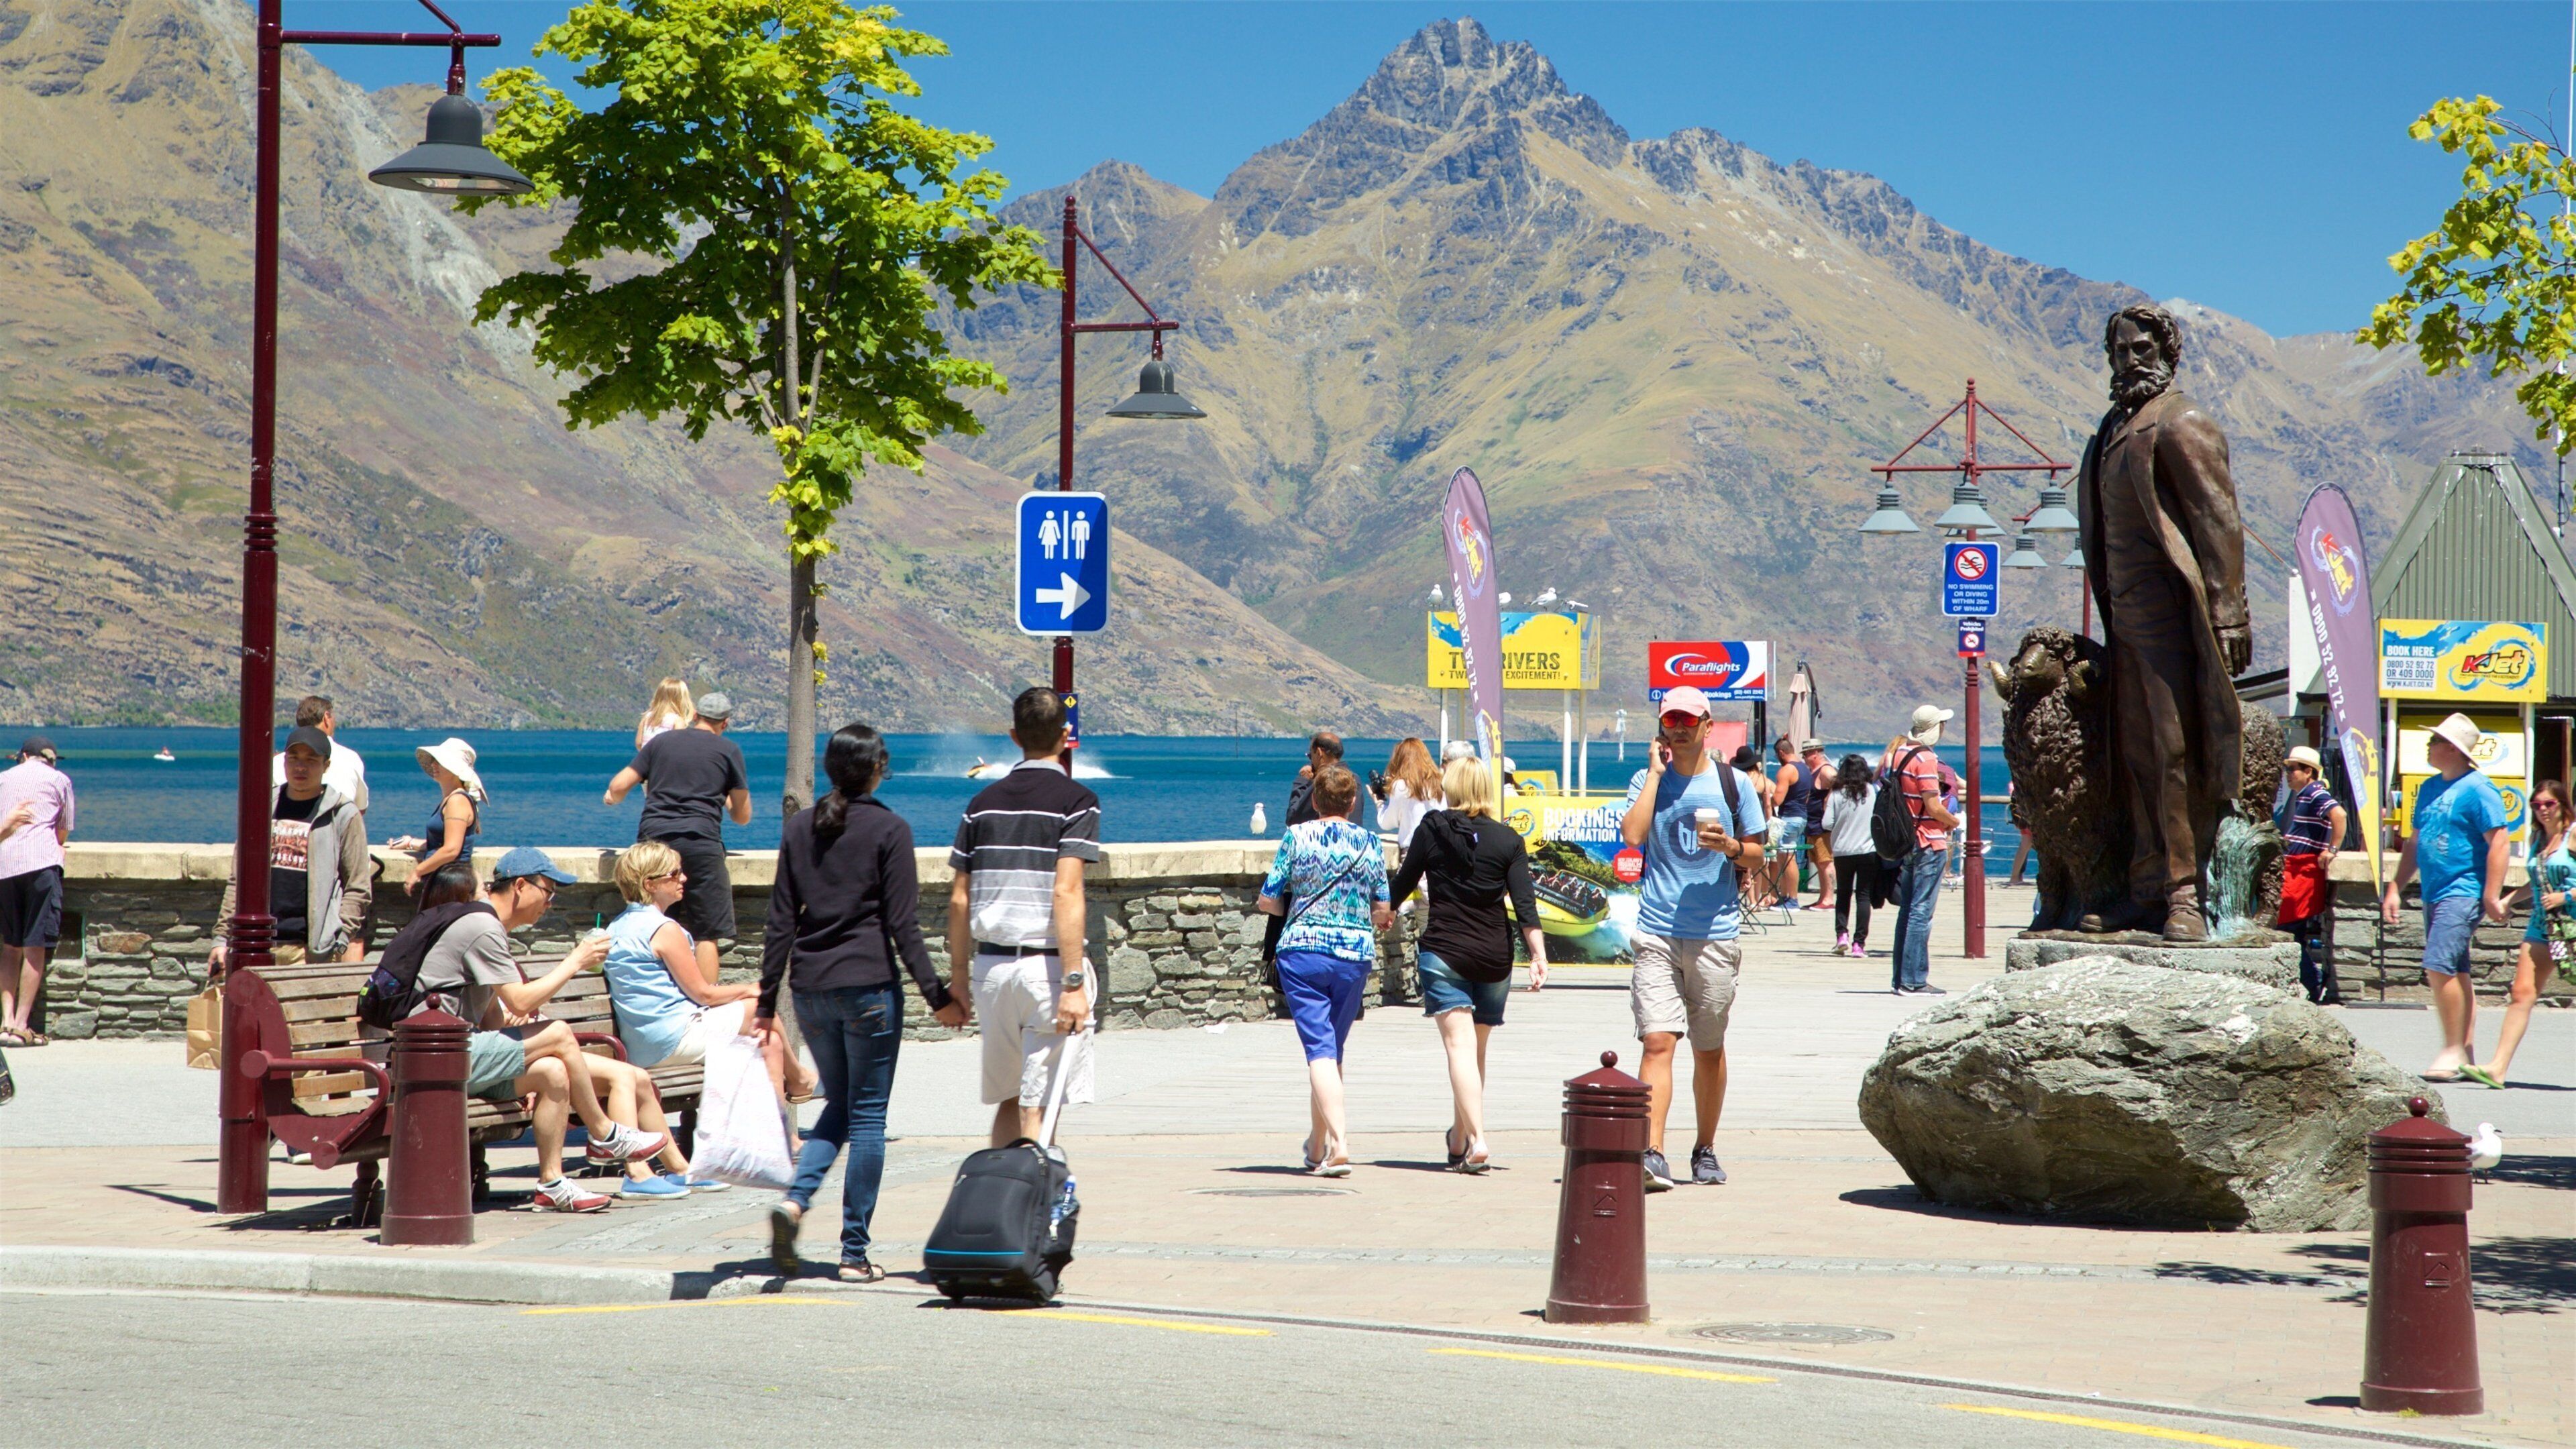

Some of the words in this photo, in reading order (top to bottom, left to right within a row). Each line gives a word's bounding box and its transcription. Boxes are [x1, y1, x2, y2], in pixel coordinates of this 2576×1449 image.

[2322, 532, 2354, 596] KJet
[2312, 602, 2328, 643] 0800
[1454, 585, 1466, 625] 0800
[1461, 625, 1470, 647] 52
[1468, 667, 1477, 690] 72
[2321, 643, 2334, 665] 52
[2387, 645, 2410, 656] BOOK
[2412, 646, 2435, 657] HERE
[2461, 649, 2525, 674] KJet
[1682, 662, 1741, 674] Paraflights
[2387, 659, 2404, 668] 0800
[2406, 660, 2414, 669] 52
[2416, 661, 2424, 669] 92
[2426, 661, 2434, 669] 72
[2387, 669, 2397, 678] OR
[2398, 669, 2413, 678] 409
[2415, 669, 2434, 679] 0000
[1505, 671, 1560, 680] EXCITEMENT!
[2326, 665, 2339, 688] 92
[1704, 691, 1732, 699] Bookings
[2332, 686, 2344, 709] 72
[1544, 807, 1625, 829] BOOKINGS
[1544, 827, 1617, 843] INFORMATION
